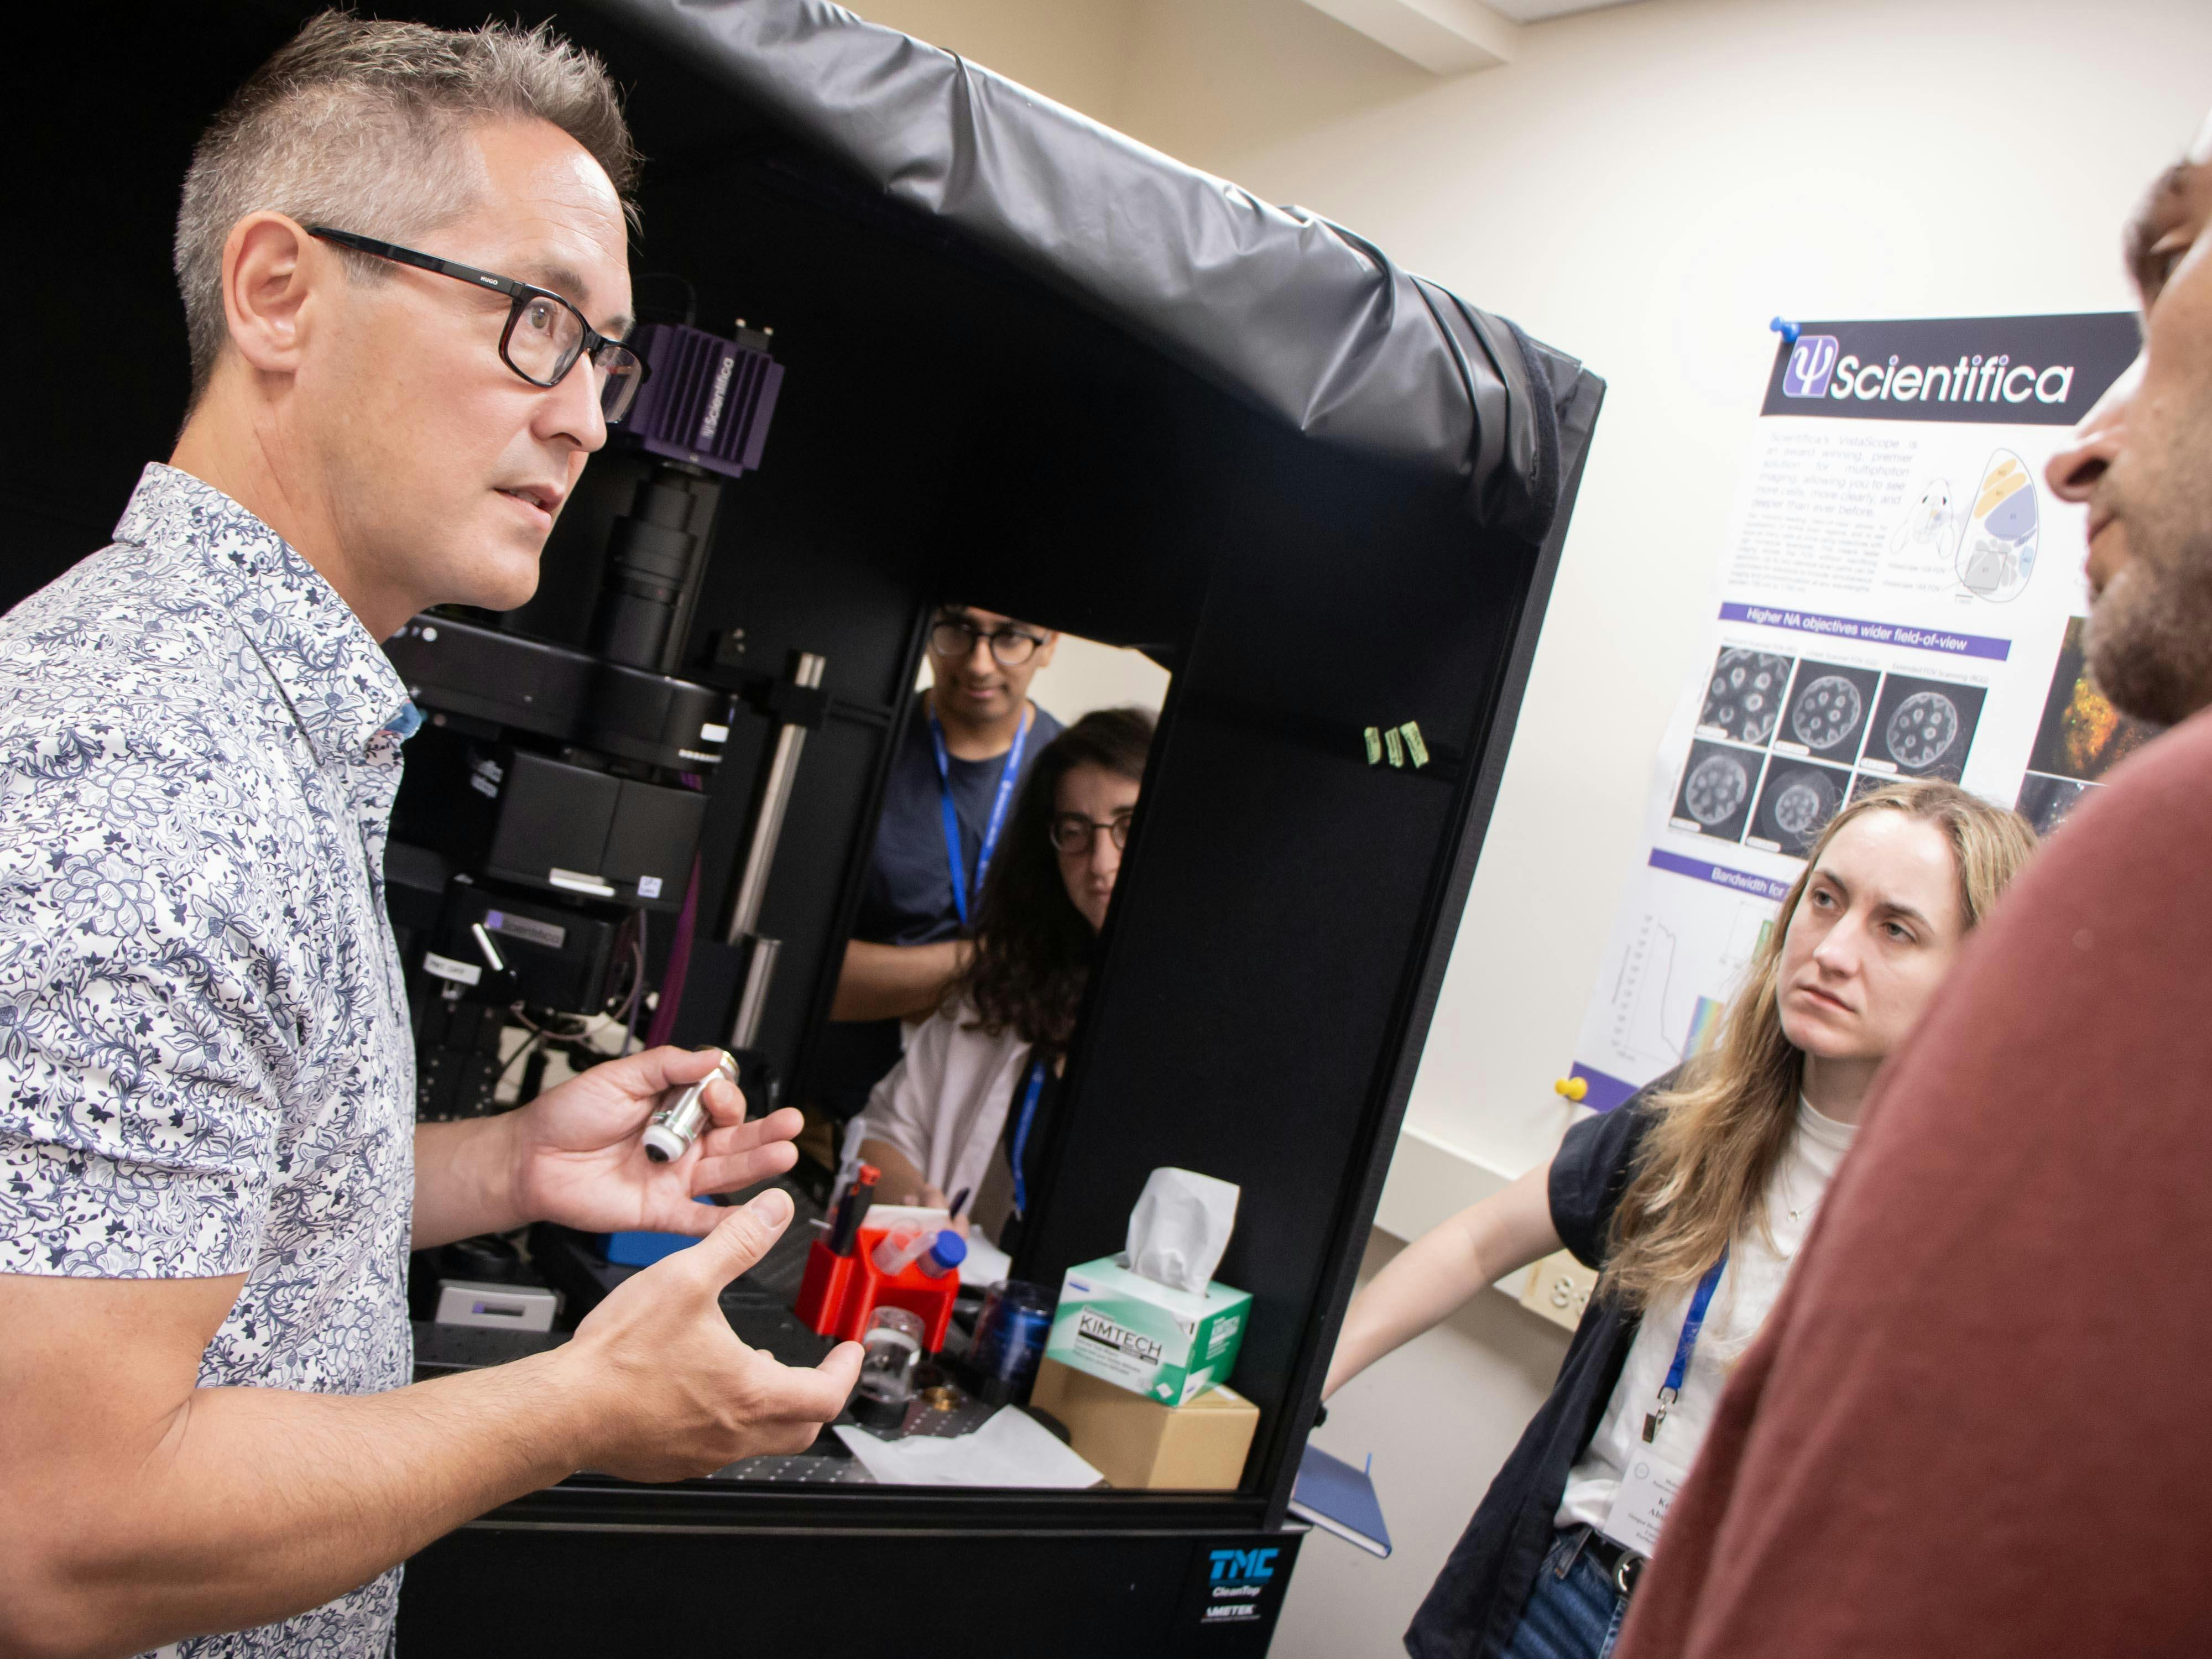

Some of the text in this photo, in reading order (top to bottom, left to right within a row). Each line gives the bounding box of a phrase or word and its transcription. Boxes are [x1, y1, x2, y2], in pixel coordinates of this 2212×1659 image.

[480, 276, 498, 285] HUGO
[1830, 354, 2074, 403] Scientifica
[1844, 465, 1910, 477] multiphoton
[1849, 479, 1869, 495] you
[1872, 478, 1883, 490] to
[1886, 482, 1906, 491] see
[1880, 494, 1902, 505] and
[1746, 607, 1968, 650] Higher NA objectives wider field-of-view
[1711, 867, 1767, 894] Bandwidth
[1079, 1314, 1163, 1357] KIMTECH
[1209, 1548, 1280, 1580] TMC
